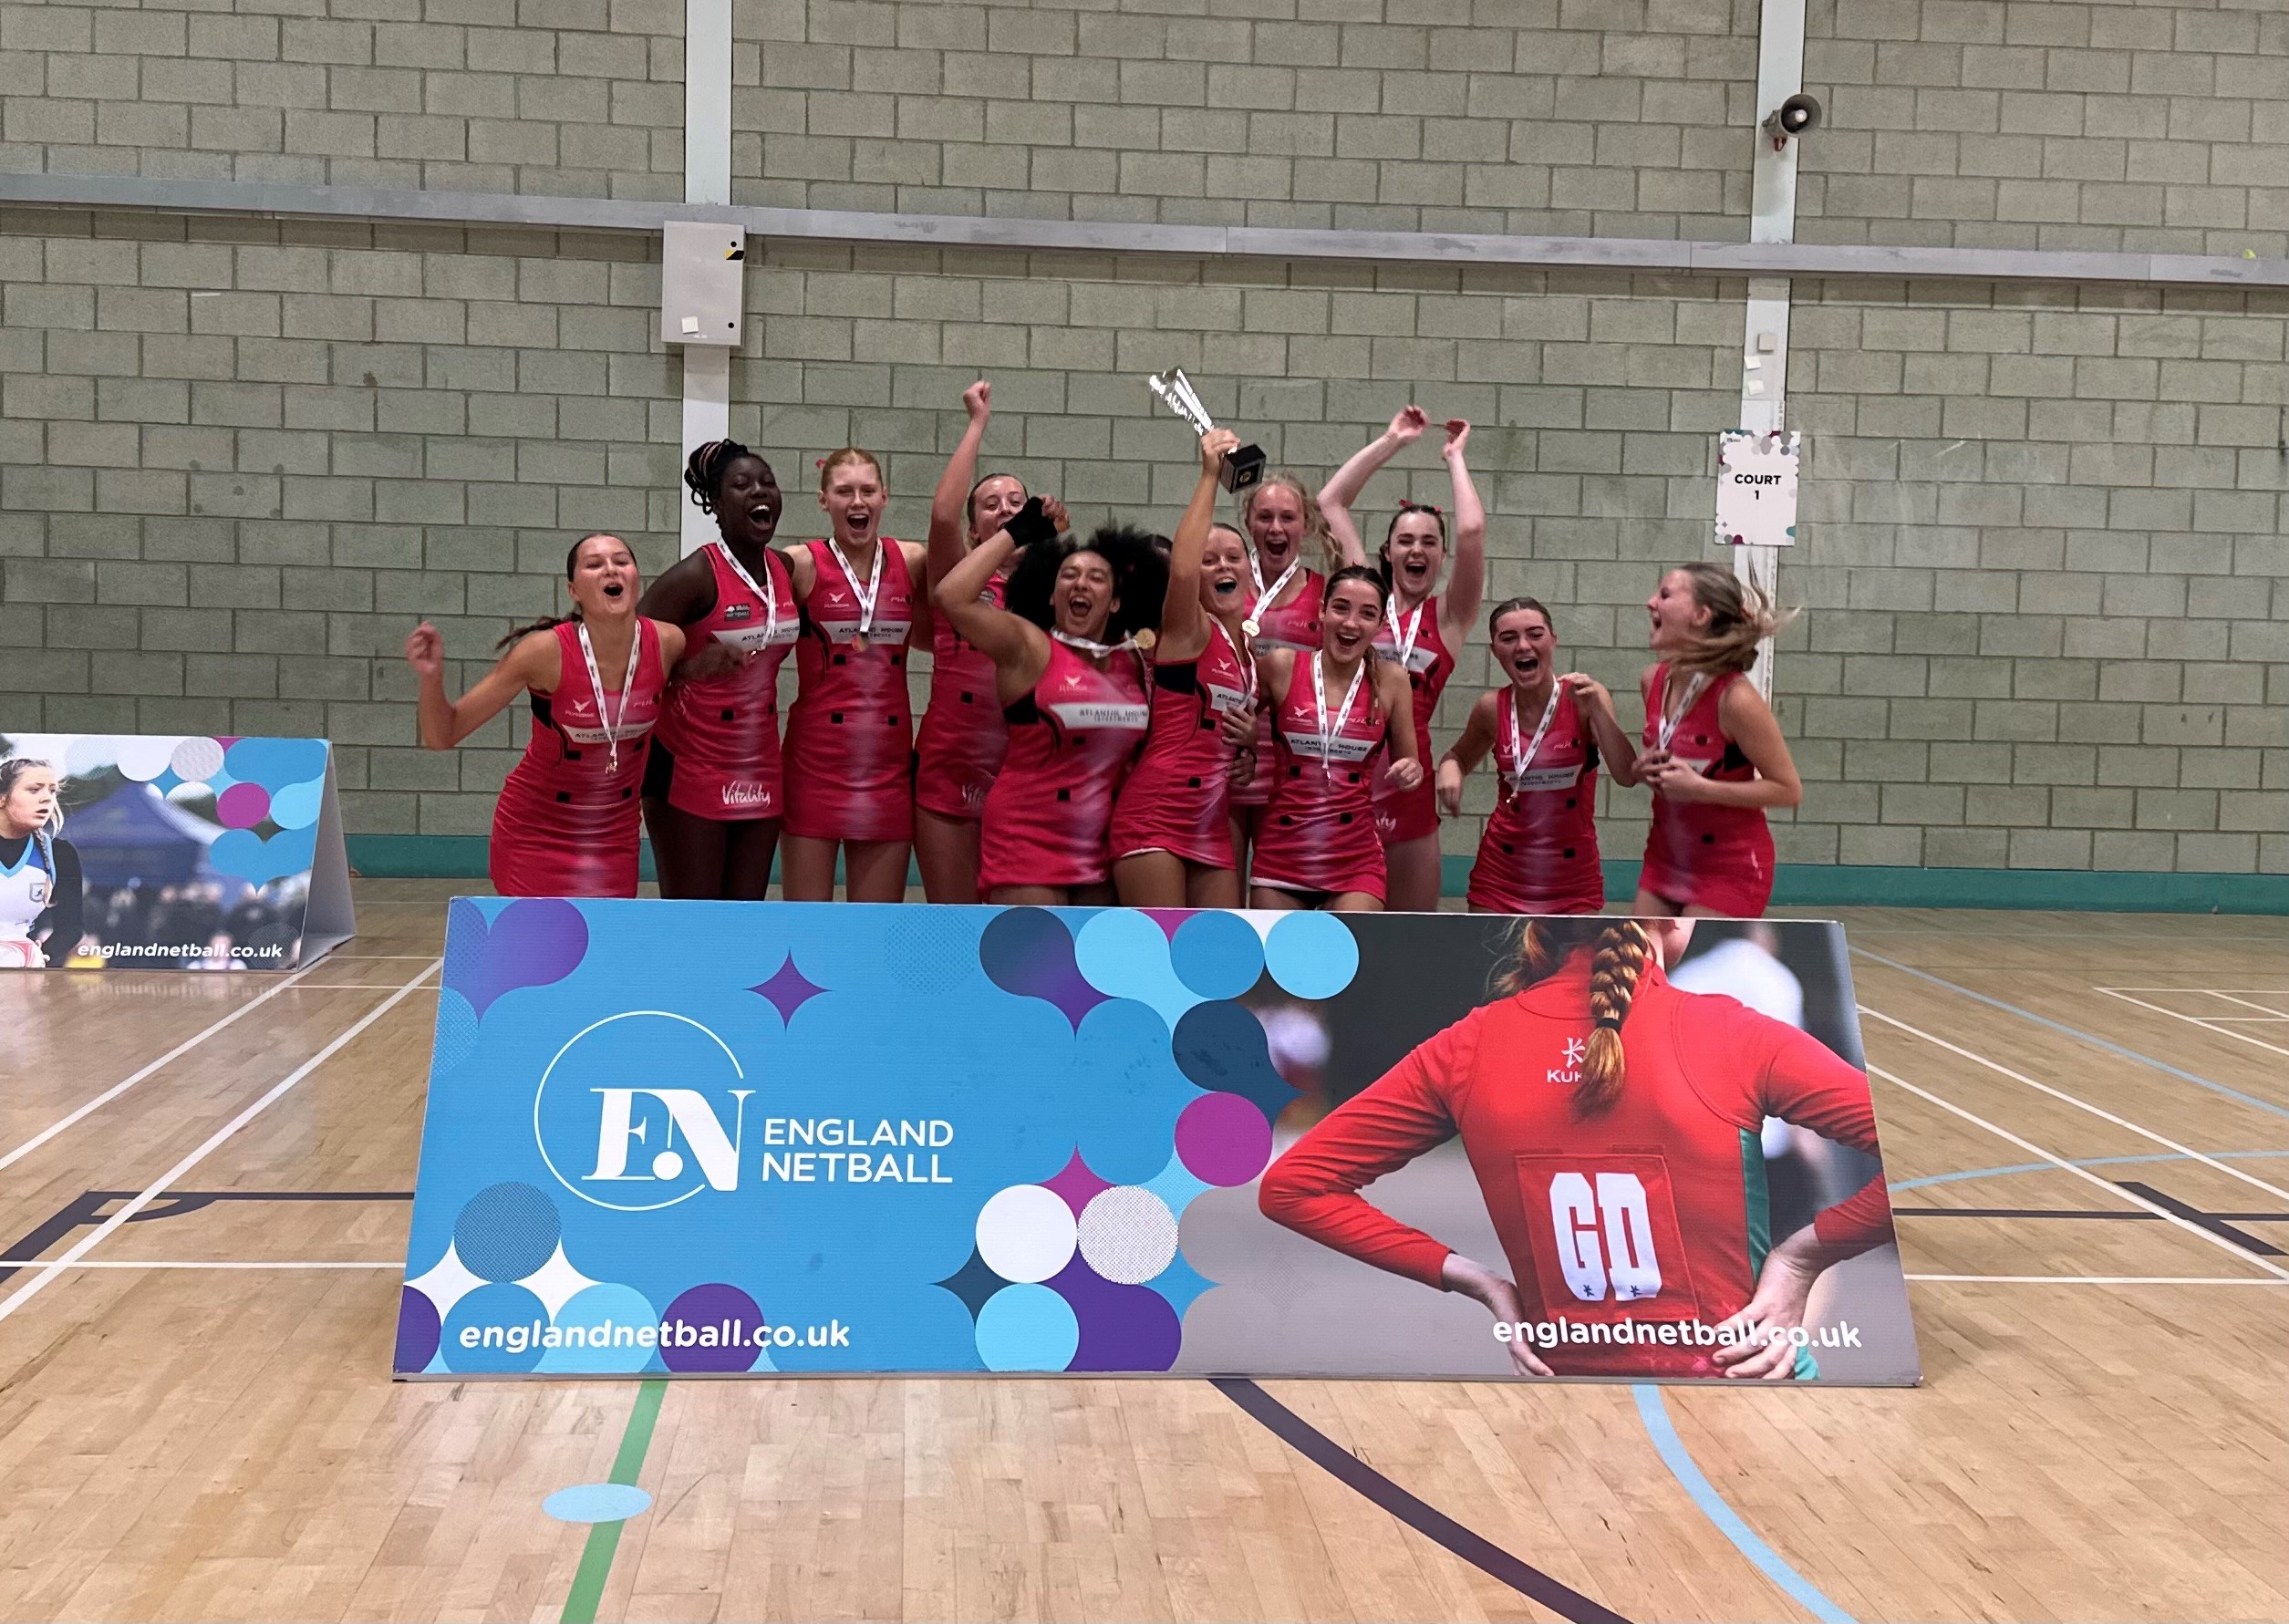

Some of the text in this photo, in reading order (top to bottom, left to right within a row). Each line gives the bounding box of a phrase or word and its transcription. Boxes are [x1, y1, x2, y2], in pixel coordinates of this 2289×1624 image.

[1735, 474, 1781, 485] COURT
[1755, 490, 1759, 500] 1
[722, 781, 771, 809] Vitality
[78, 943, 283, 958] englandnetball.co.uk
[764, 1118, 954, 1147] ENGLAND
[762, 1153, 953, 1183] NETBALL
[1549, 1173, 1662, 1301] GD
[459, 1319, 850, 1353] englandnetball.co.uk
[1492, 1316, 1862, 1348] englandnetball.co.uk
